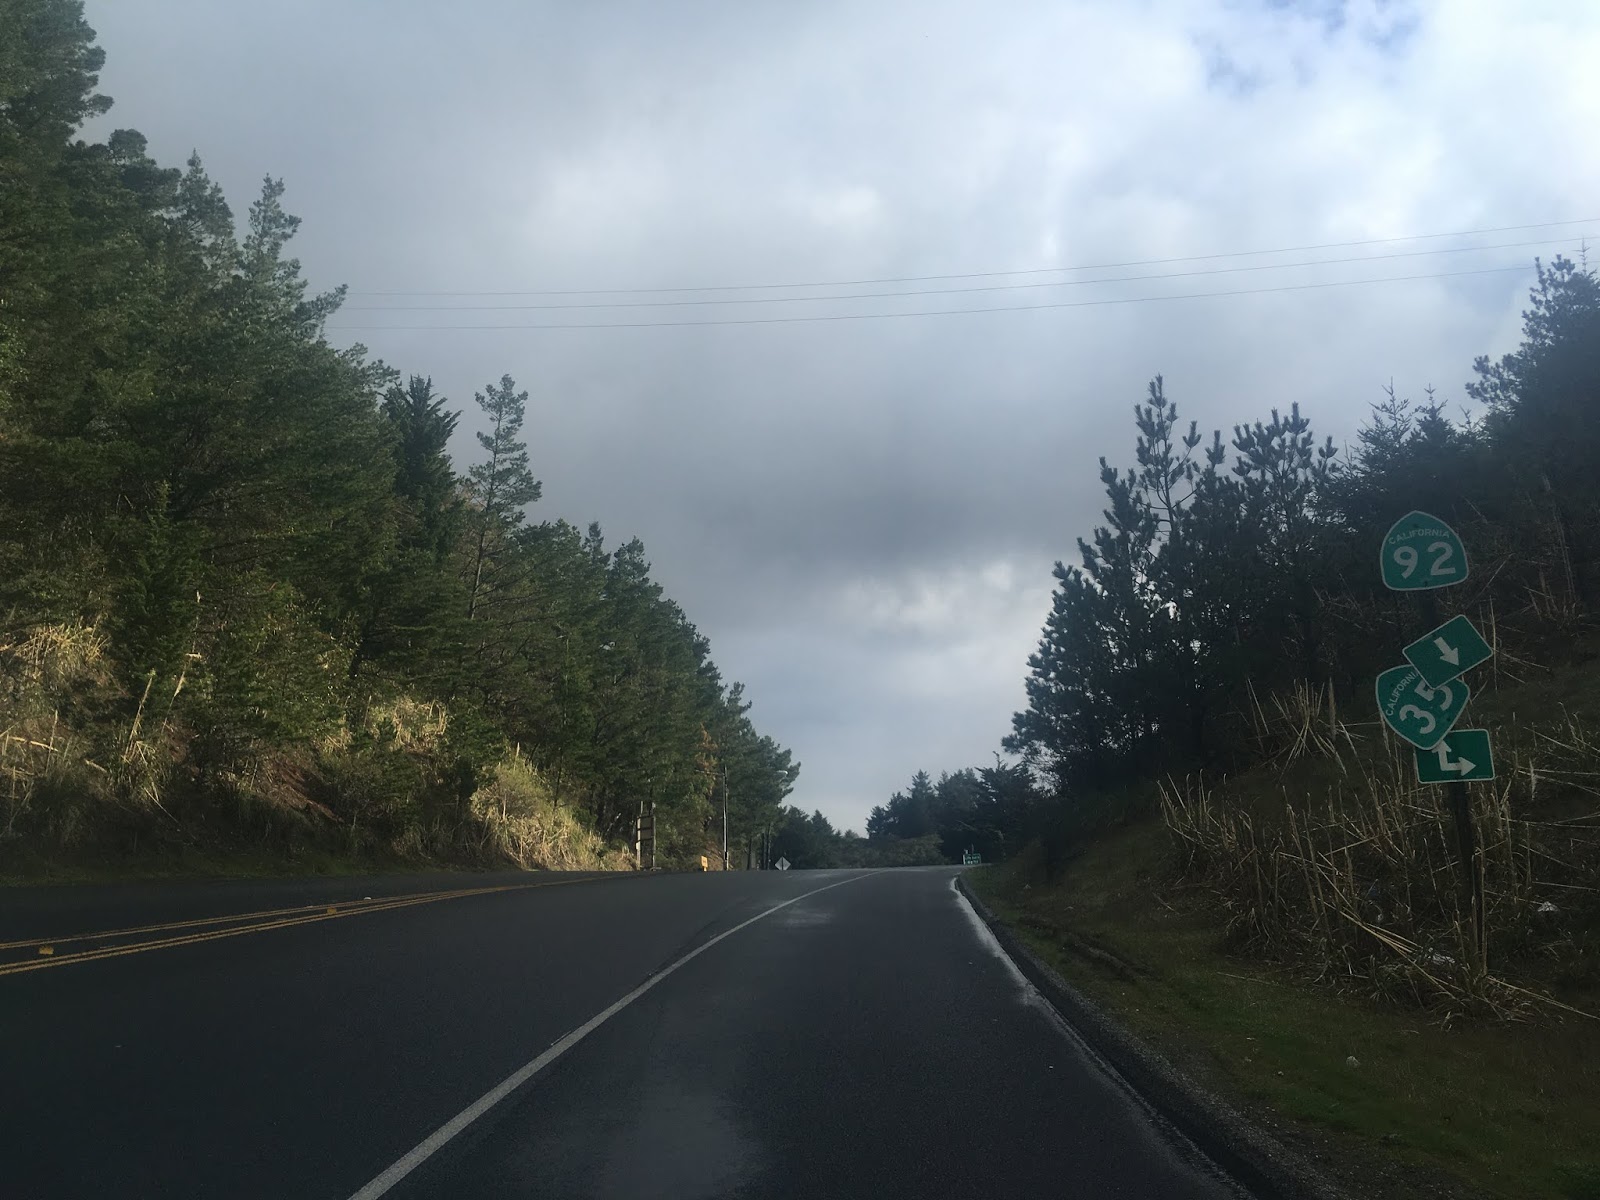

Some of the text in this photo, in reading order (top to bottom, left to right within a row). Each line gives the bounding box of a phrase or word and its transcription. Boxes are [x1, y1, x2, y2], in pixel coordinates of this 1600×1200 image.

[1388, 528, 1450, 545] CALIFORNIA
[1393, 541, 1456, 579] 92
[1399, 680, 1453, 734] 35
